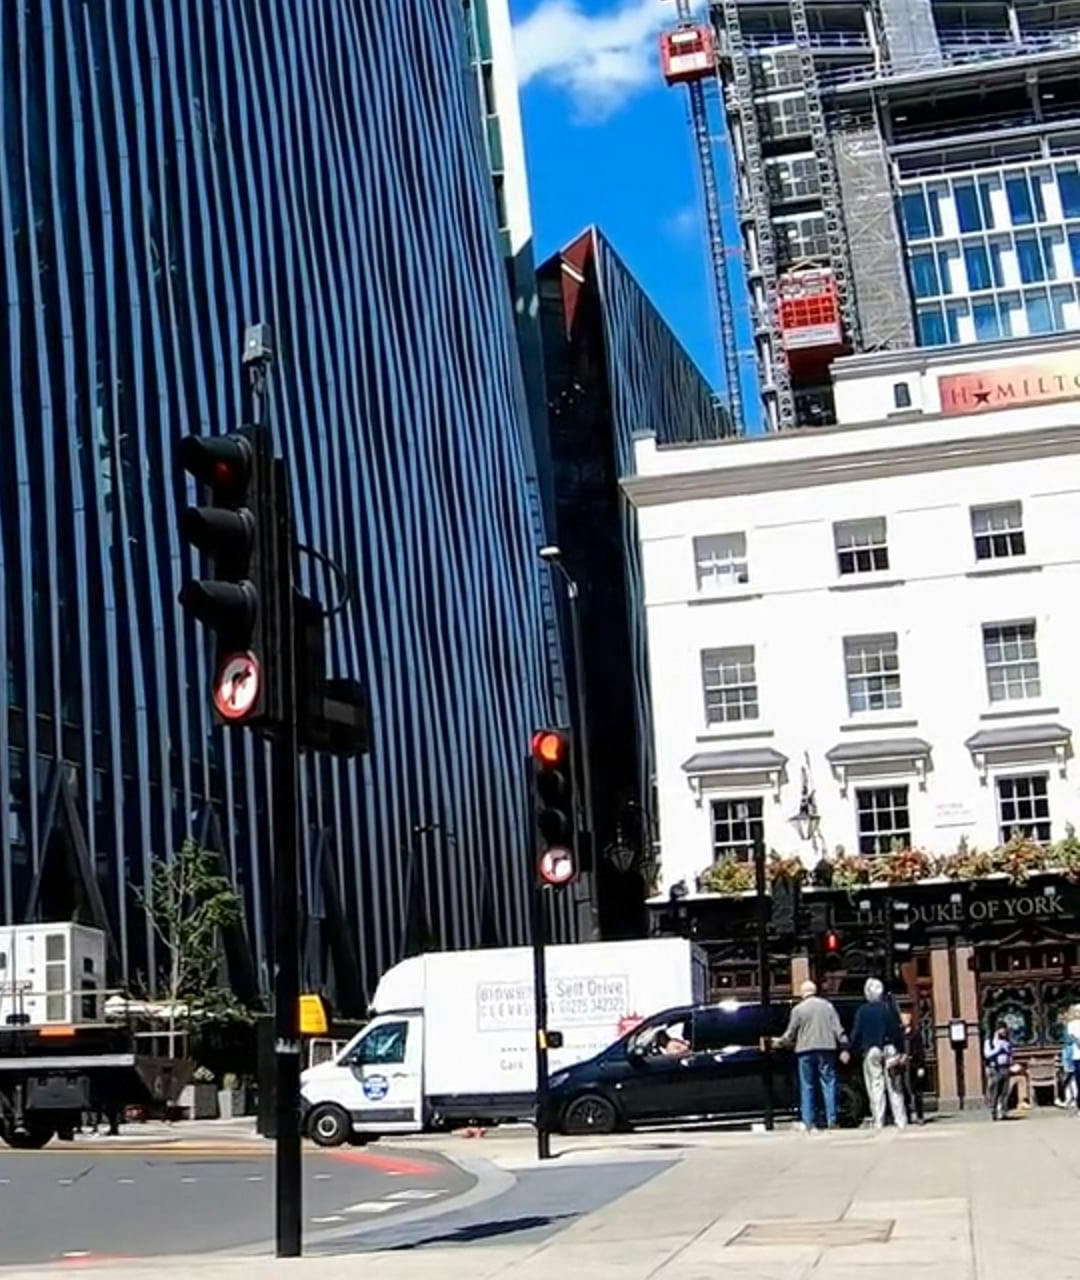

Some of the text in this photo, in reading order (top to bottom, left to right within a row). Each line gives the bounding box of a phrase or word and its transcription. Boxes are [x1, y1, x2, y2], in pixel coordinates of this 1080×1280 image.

[855, 894, 1064, 926] TH DUKE OF YORK
[587, 979, 623, 996] Drive
